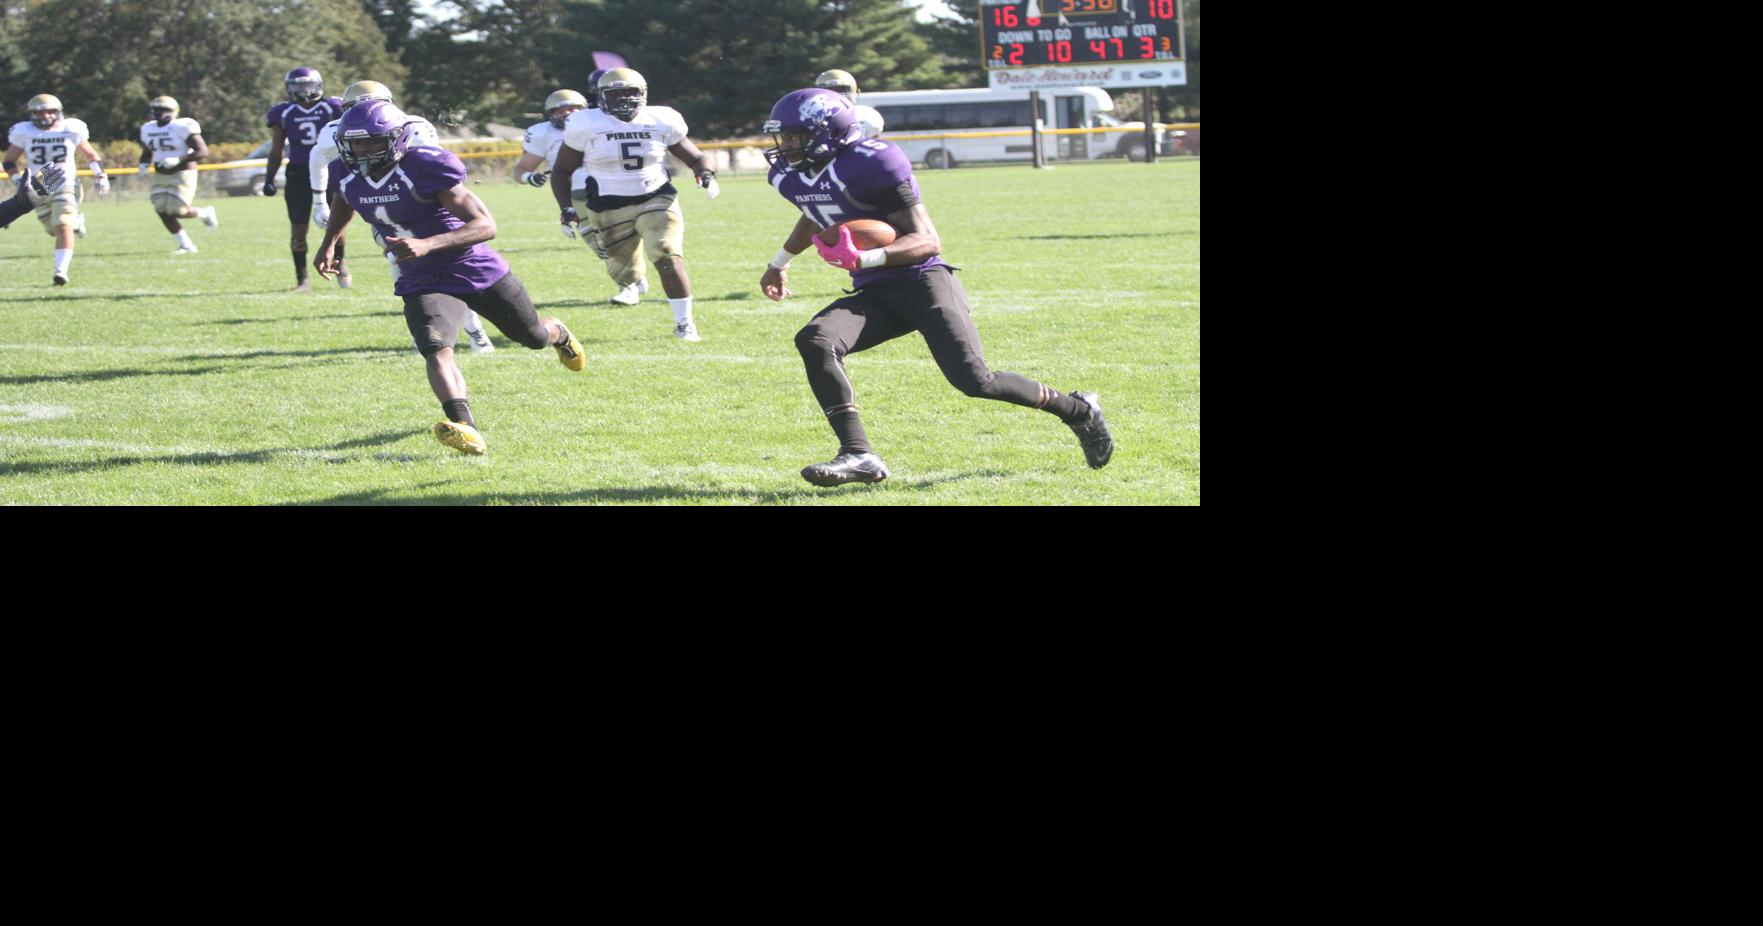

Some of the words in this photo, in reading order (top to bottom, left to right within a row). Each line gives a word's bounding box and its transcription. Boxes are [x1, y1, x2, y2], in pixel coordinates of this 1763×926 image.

[994, 5, 1019, 28] 16
[1148, 0, 1174, 19] 10
[997, 30, 1034, 44] DOWN
[1037, 29, 1053, 42] TO
[1054, 28, 1072, 41] GO
[1084, 26, 1111, 40] BALL
[1111, 25, 1128, 38] ON
[1132, 23, 1157, 38] QTR
[992, 44, 1004, 60] 2
[1047, 41, 1072, 63] 10
[1090, 37, 1124, 60] 47
[1139, 36, 1154, 59] 3
[1161, 36, 1171, 51] 3
[1009, 43, 1025, 65] 2
[299, 121, 317, 145] 3
[605, 131, 652, 141] PIRATES
[148, 137, 175, 152] 45
[854, 139, 888, 157] 15
[31, 145, 67, 165] 32
[619, 141, 645, 171] 5
[359, 194, 400, 203] PANTHERS
[795, 194, 832, 202] PANTHERS
[374, 206, 414, 238] 1
